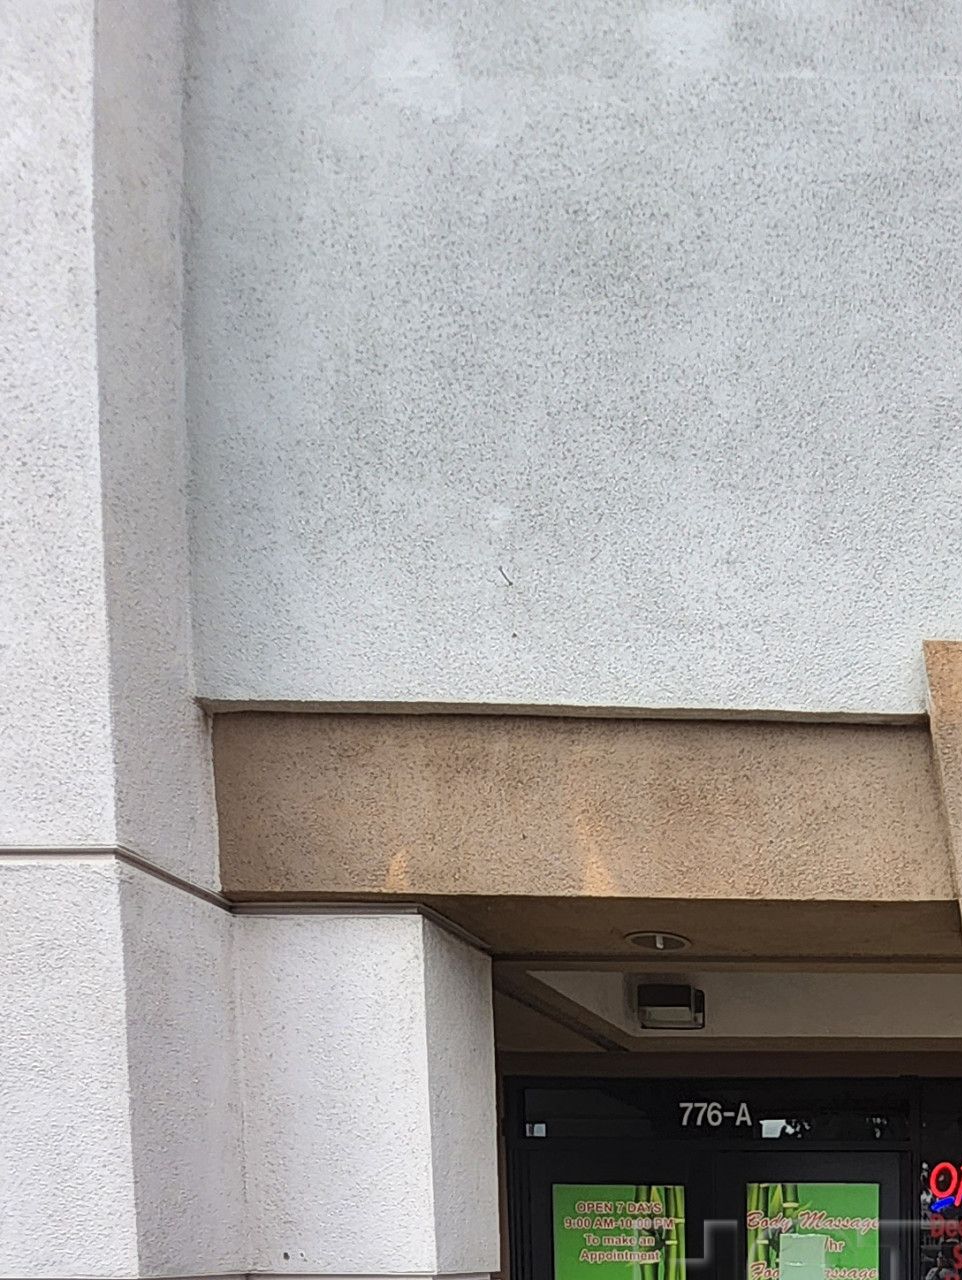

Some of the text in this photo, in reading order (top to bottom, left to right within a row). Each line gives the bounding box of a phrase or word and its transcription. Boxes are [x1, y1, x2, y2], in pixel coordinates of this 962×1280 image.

[679, 1102, 752, 1126] 776-A
[576, 1202, 663, 1214] OPEN 7 DAYS
[564, 1217, 591, 1229] 9:00
[654, 1217, 675, 1229] PM
[747, 1210, 880, 1235] Body Massage
[584, 1233, 656, 1247] To make an
[580, 1249, 661, 1264] Appointment
[750, 1262, 780, 1280] Foo
